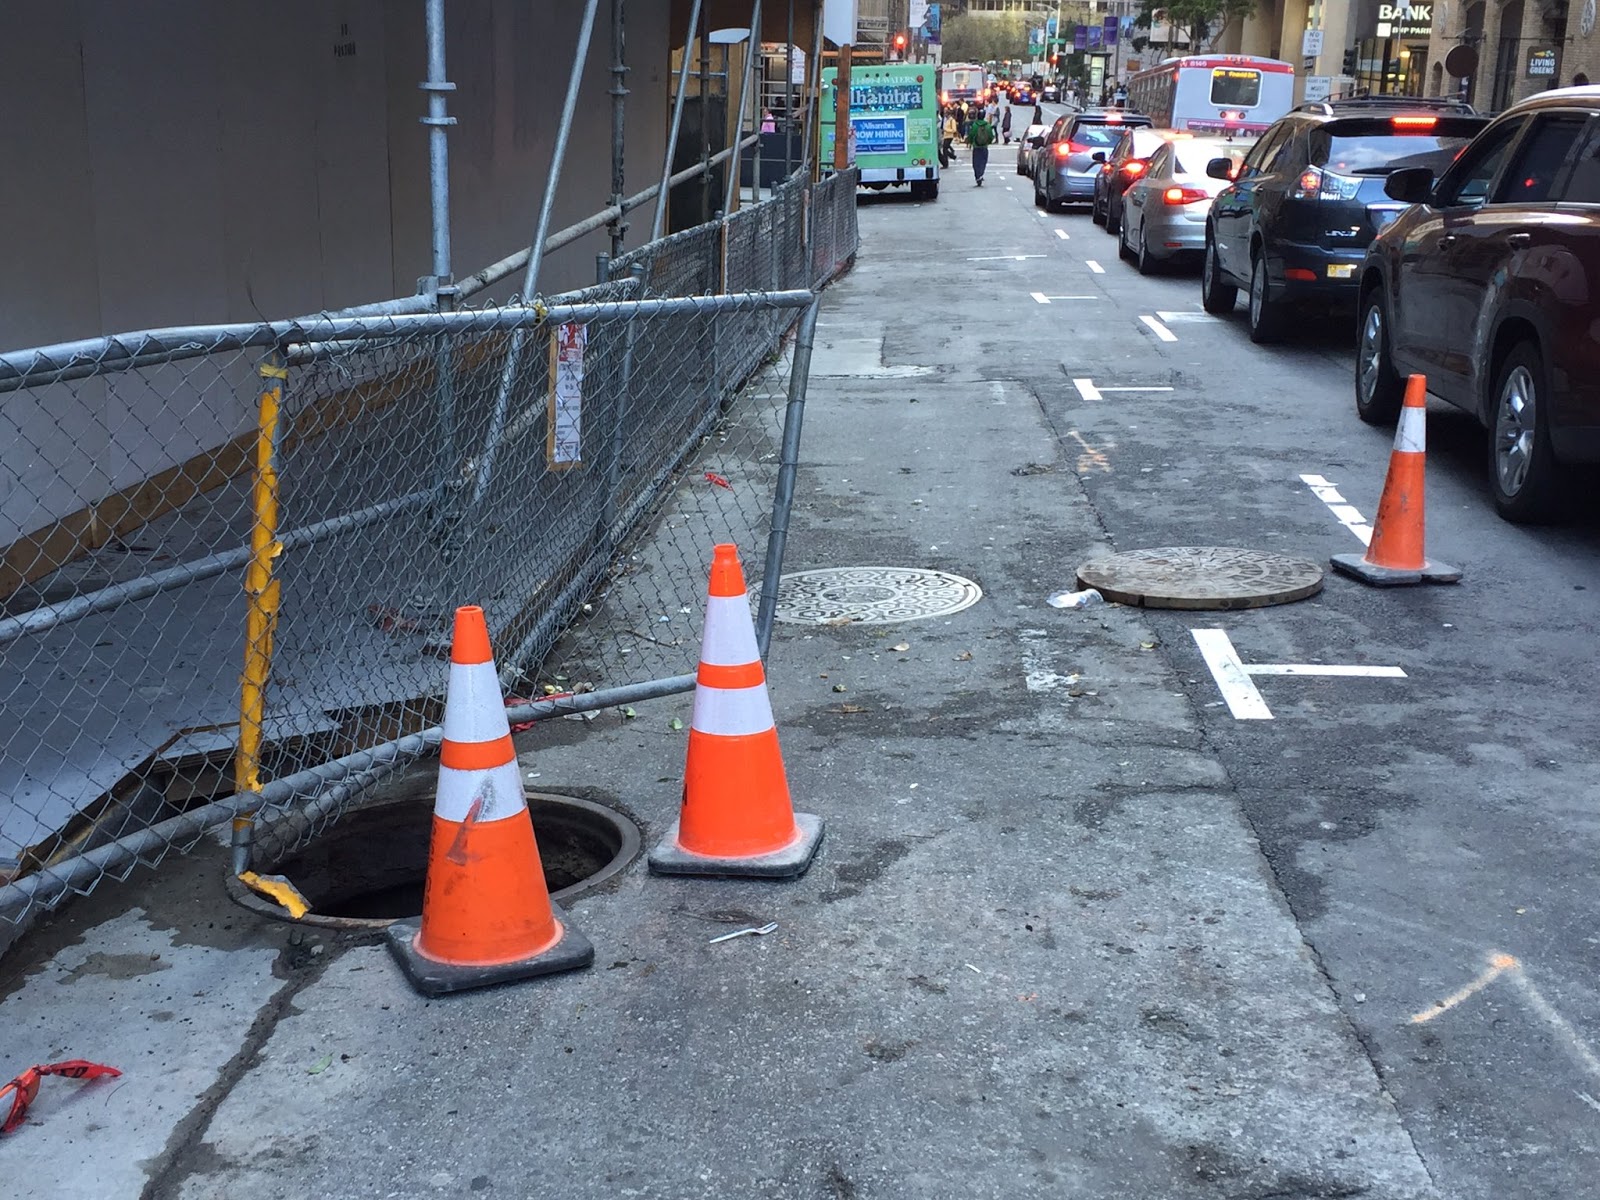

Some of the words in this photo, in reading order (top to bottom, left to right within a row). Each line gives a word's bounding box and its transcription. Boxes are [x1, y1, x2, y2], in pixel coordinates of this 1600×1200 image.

[1379, 4, 1431, 20] BANK
[1530, 58, 1555, 67] LIVING
[1529, 66, 1555, 75] GREENS
[850, 88, 921, 106] lhambra
[874, 129, 904, 139] HIRING
